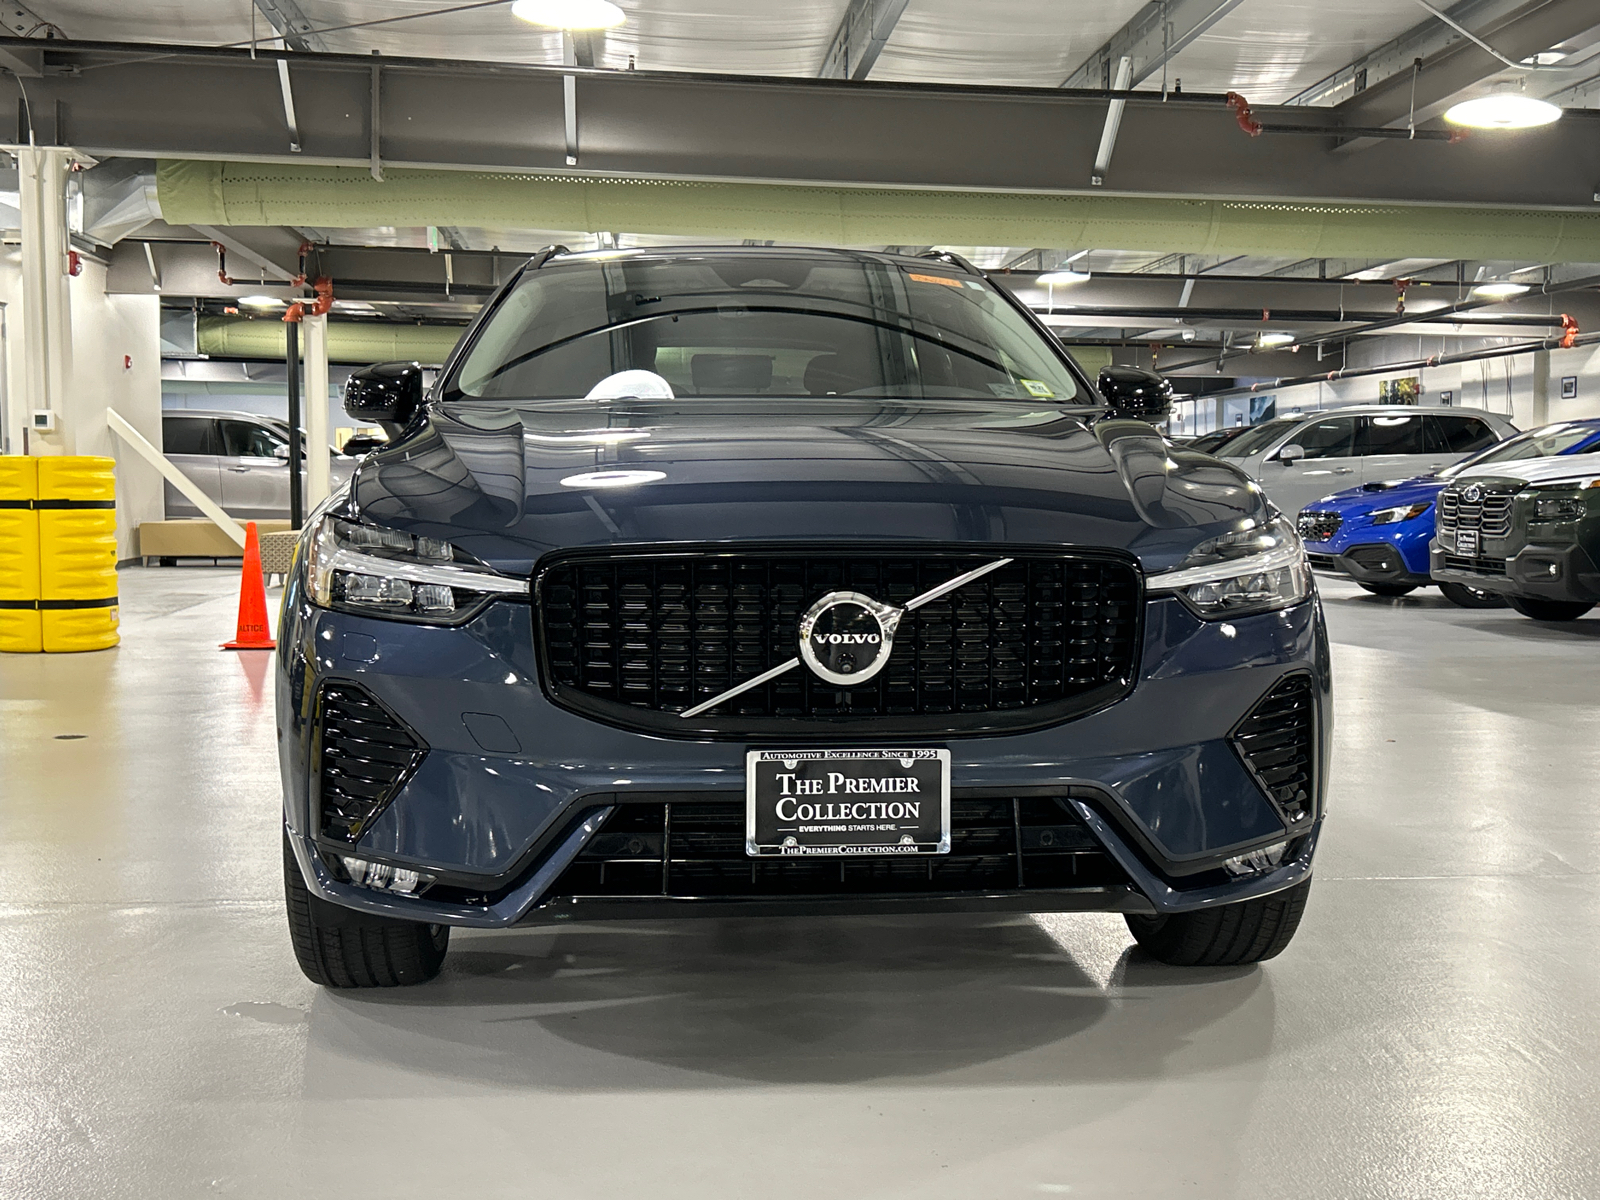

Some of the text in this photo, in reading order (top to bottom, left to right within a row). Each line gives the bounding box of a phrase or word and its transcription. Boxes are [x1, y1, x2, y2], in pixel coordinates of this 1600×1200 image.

[813, 633, 880, 644] VOLVO
[911, 750, 936, 758] 1995
[775, 772, 920, 795] THE PREMIER
[775, 797, 920, 821] COLLECTION
